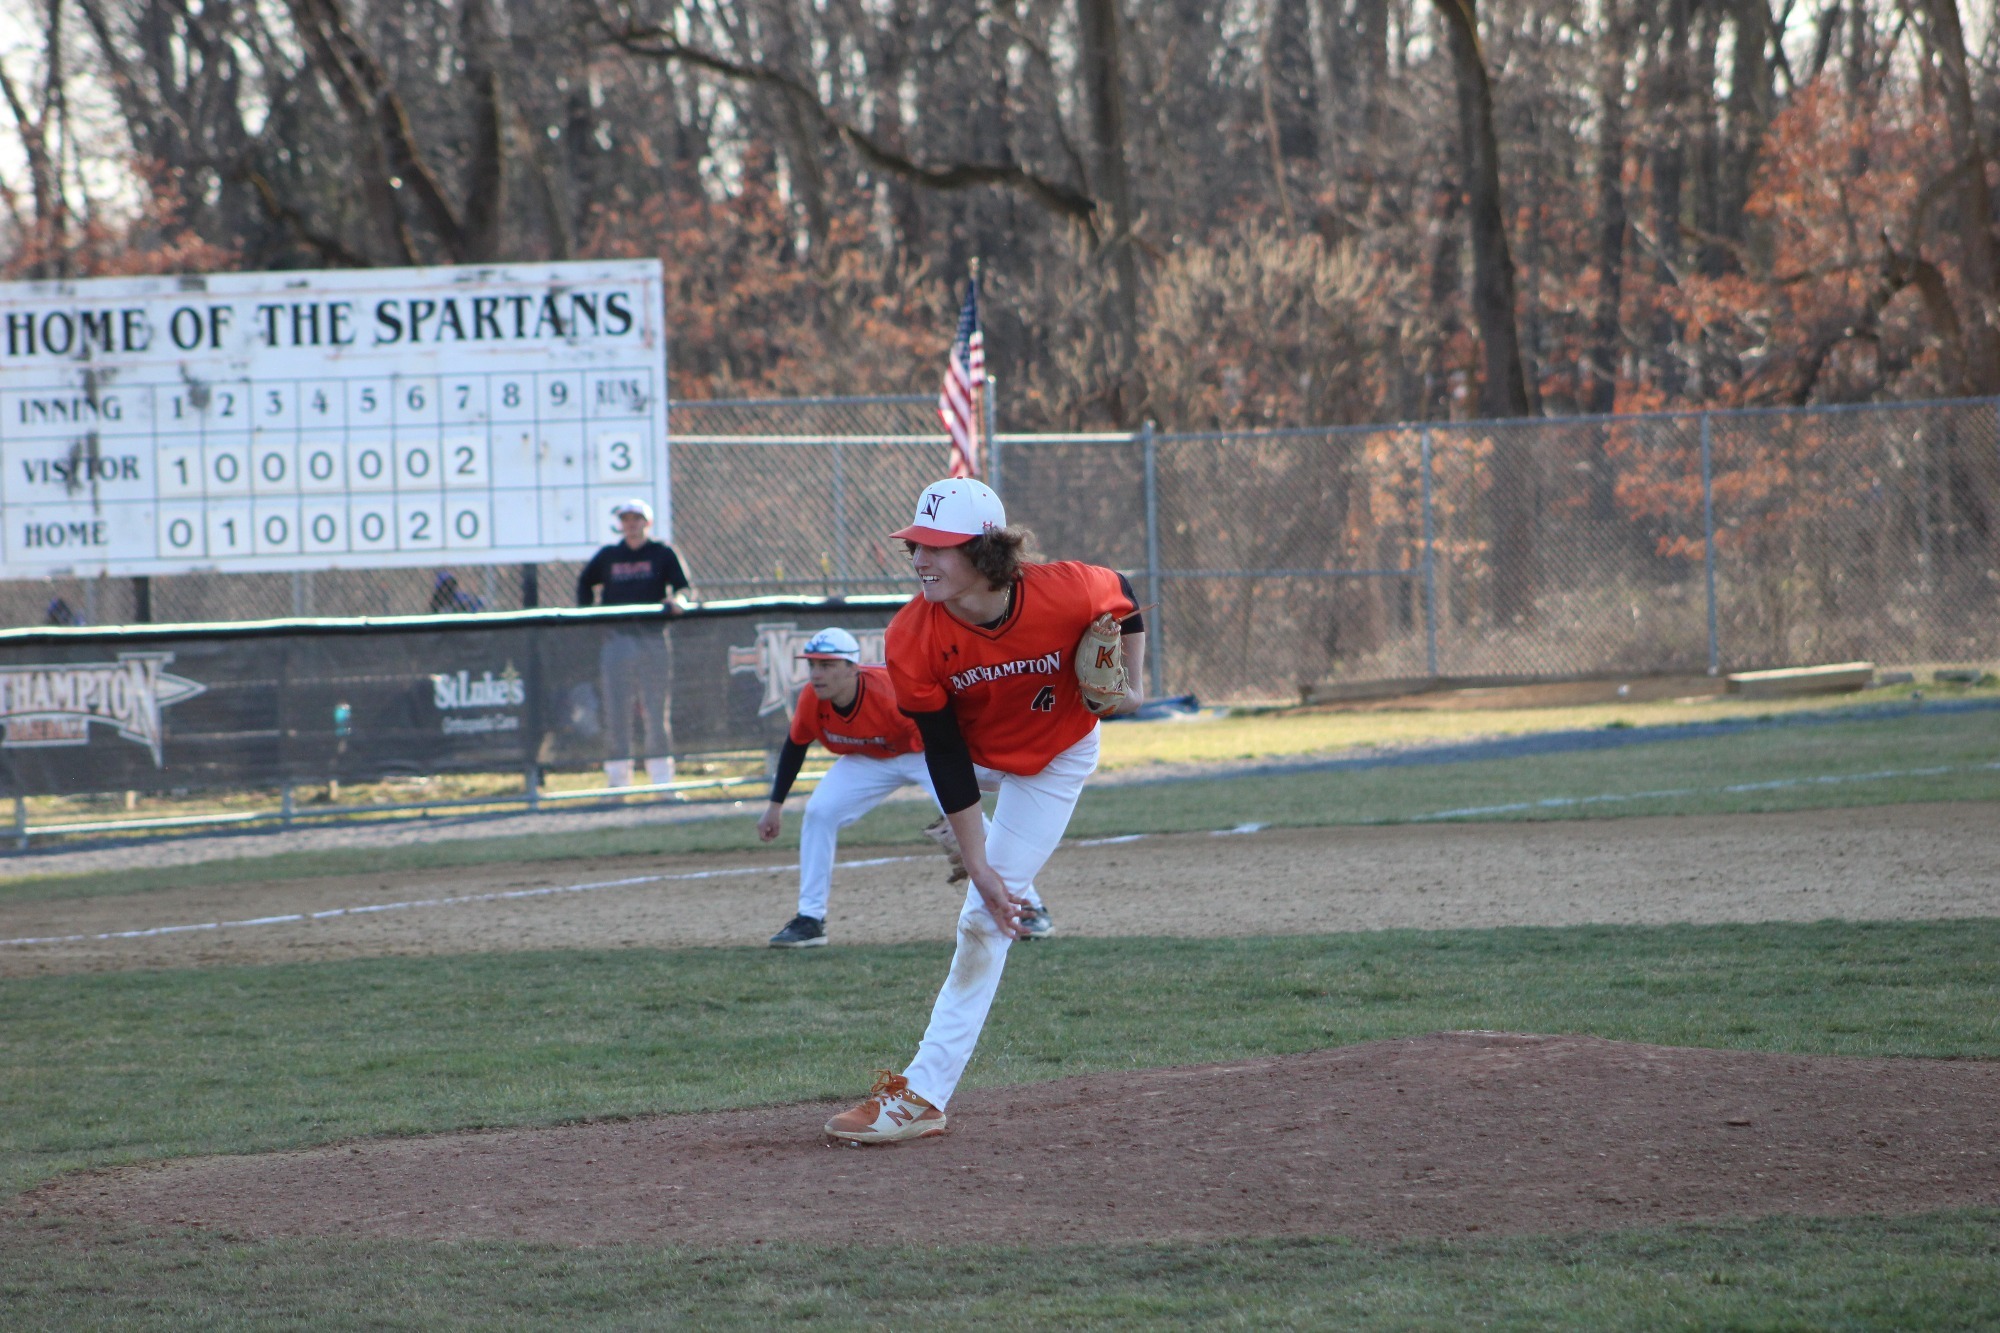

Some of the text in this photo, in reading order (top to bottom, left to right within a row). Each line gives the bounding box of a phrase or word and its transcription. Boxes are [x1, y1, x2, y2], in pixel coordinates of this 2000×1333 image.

[6, 292, 633, 355] HOME OF THE SPARTANS
[19, 395, 122, 424] INNING
[173, 396, 183, 419] 1
[220, 393, 235, 416] 2
[266, 391, 282, 415] 3
[312, 389, 328, 415] 4
[359, 388, 376, 412] 5
[408, 385, 426, 411] 6
[456, 385, 470, 409] 7
[503, 383, 520, 408] 8
[550, 382, 568, 407] 9
[22, 442, 632, 485] VISITOR 1 0 0 0 0 0 2 3
[25, 511, 479, 548] HOME 0 1 0 0 0 2 0
[950, 651, 1061, 694] NORTHAMPTON
[1031, 685, 1056, 712] 4
